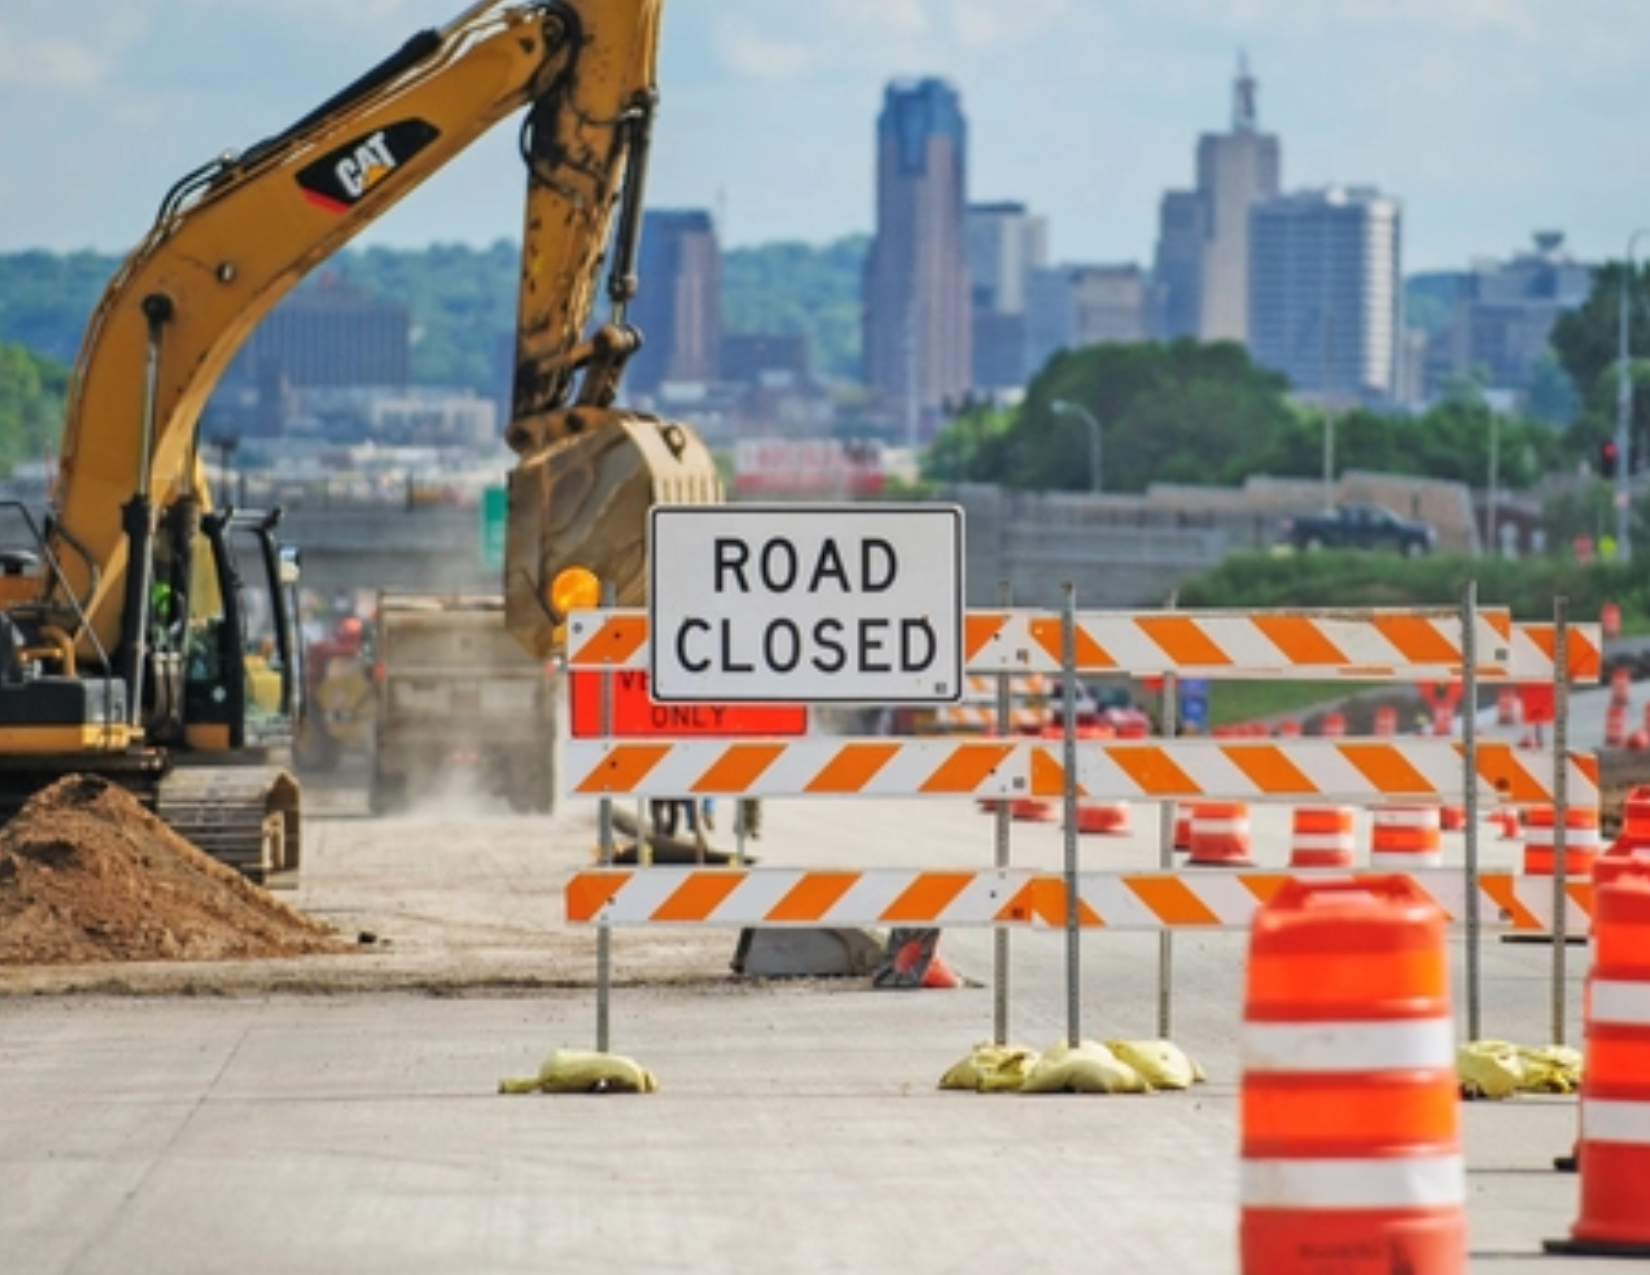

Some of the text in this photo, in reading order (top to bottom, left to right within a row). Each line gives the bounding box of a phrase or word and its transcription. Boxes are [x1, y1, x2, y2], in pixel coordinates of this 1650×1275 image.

[336, 131, 397, 197] CAT
[713, 537, 898, 593] ROAD
[675, 617, 937, 673] CLOSED
[651, 705, 727, 729] ONLY
